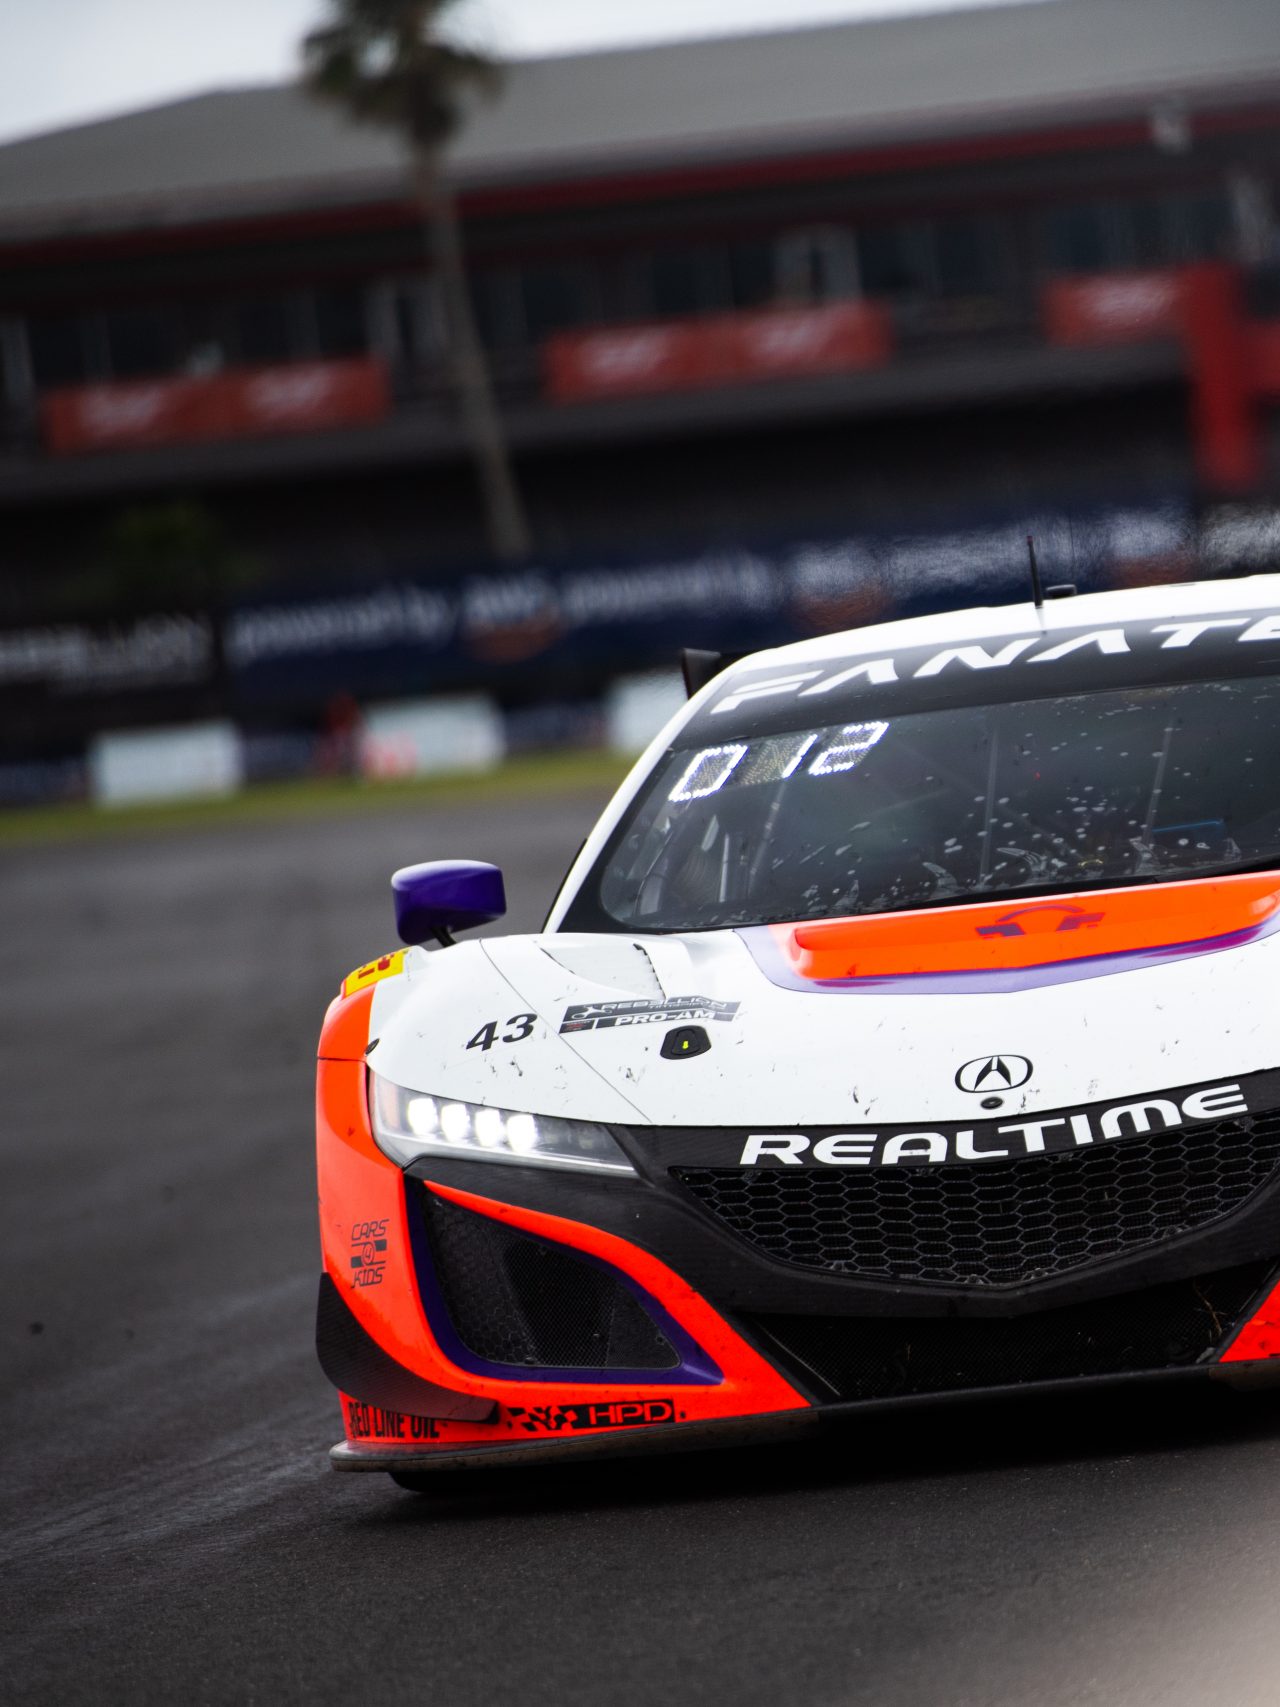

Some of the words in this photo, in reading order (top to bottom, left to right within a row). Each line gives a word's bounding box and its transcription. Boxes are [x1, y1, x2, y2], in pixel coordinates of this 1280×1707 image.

[668, 721, 890, 802] 012
[614, 1009, 716, 1026] PRO-AM
[465, 1013, 538, 1052] 43
[739, 1083, 1249, 1165] REALTIME
[351, 1218, 390, 1241] CARS
[350, 1266, 386, 1289] KIDS
[588, 1401, 673, 1426] HPD
